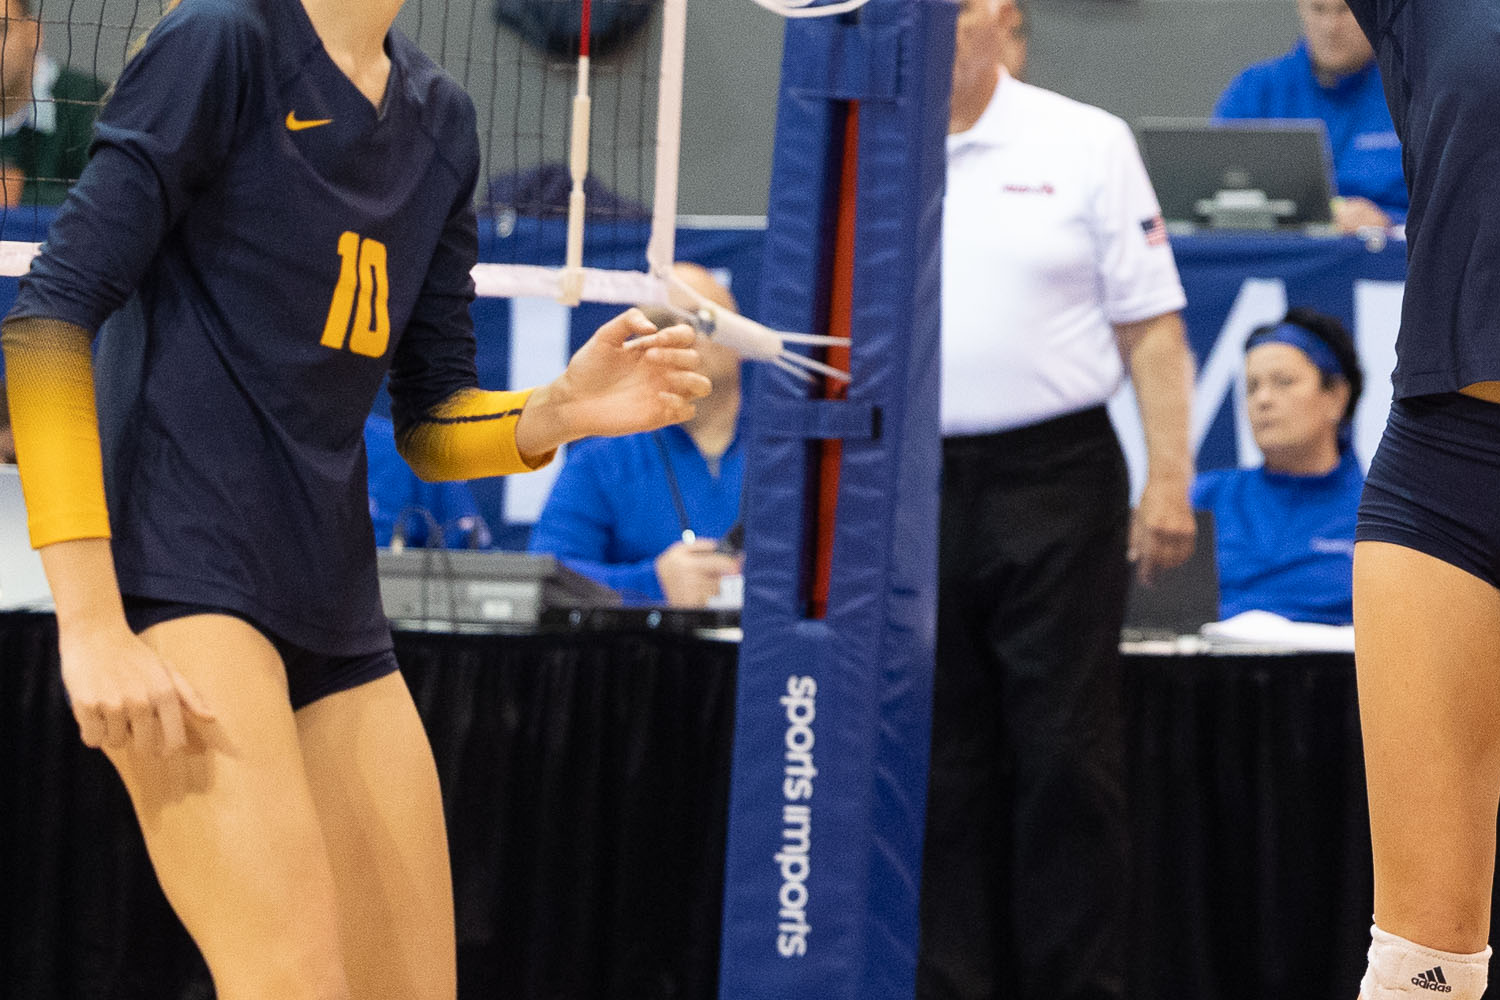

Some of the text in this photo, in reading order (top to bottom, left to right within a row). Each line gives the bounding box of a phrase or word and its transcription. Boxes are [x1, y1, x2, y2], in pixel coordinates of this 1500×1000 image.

[320, 230, 391, 359] 10
[774, 674, 818, 958] sports imports
[1410, 976, 1453, 994] adidas
